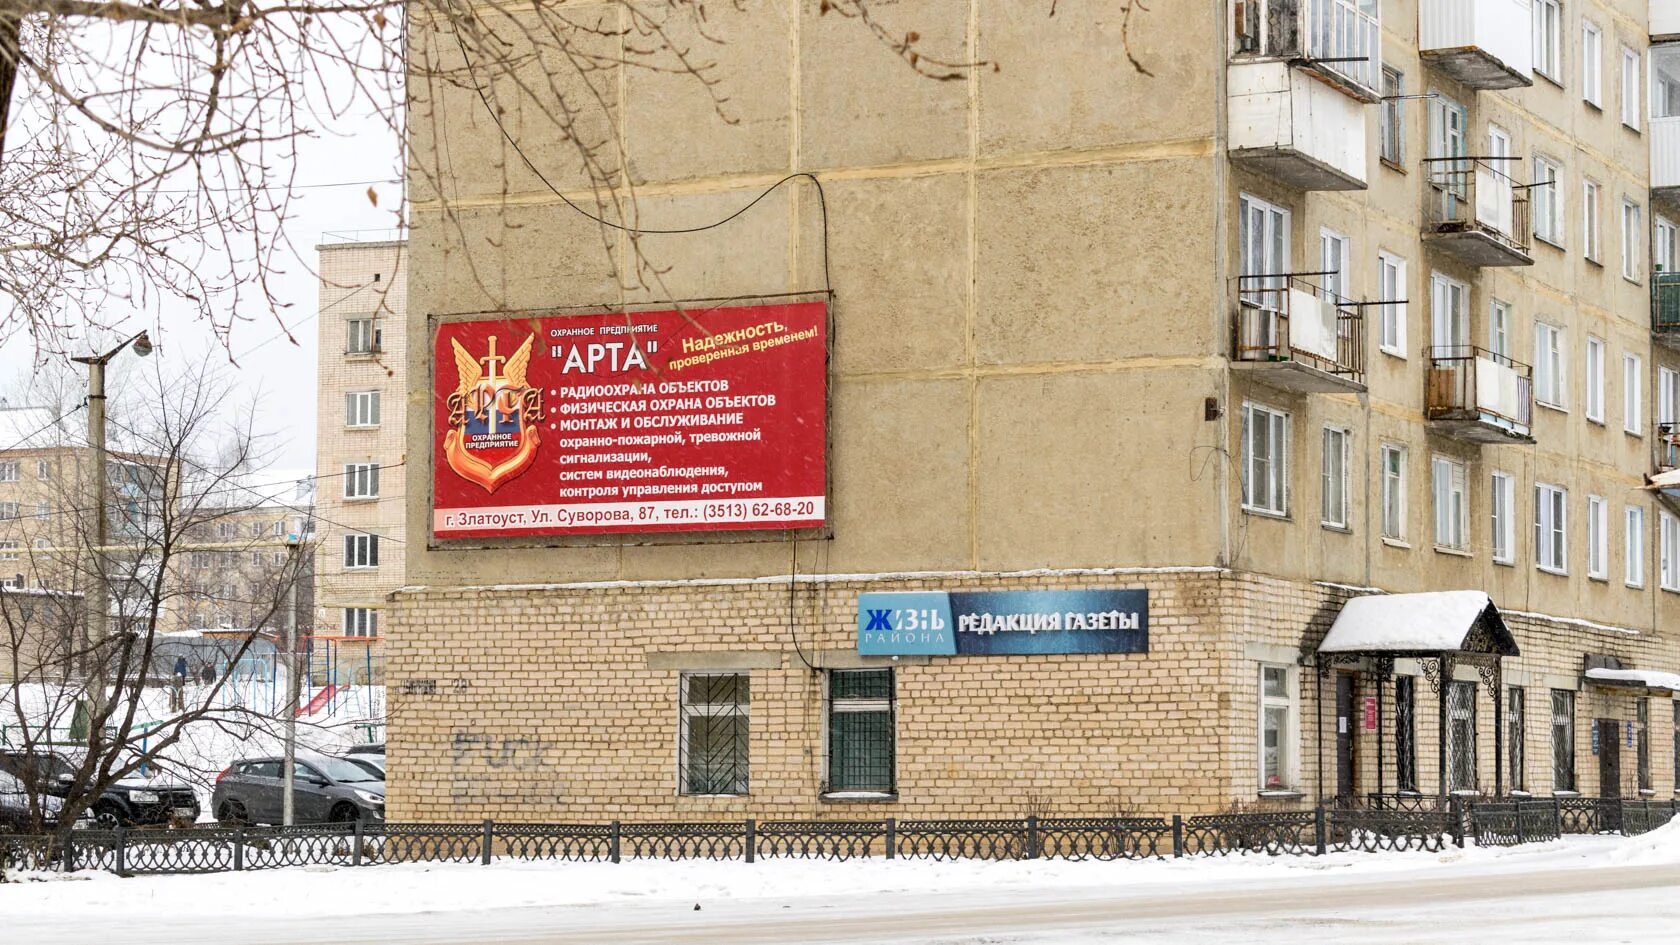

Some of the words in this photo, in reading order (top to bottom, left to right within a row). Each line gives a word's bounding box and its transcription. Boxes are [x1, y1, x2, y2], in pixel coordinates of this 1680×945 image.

[550, 327, 595, 337] ОХРАННОЕ
[599, 324, 658, 335] ПРЕДПРИЯТИЕ
[681, 321, 788, 354] Надежность,
[551, 340, 658, 374] "АРТА"
[668, 344, 750, 371] проверенная
[752, 325, 818, 352] временем!
[560, 383, 656, 399] РАДИООХРАНА
[658, 380, 729, 395] ОБЪЕКТОВ
[560, 400, 647, 415] ФИЗИЧЕСКАЯ
[649, 398, 702, 411] ОХРАНА
[705, 394, 776, 409] ОБЪЕКТОВ
[560, 417, 618, 431] МОНТАЖ
[621, 416, 630, 429] И
[633, 412, 744, 428] ОБСЛУЖИВАНИЕ
[465, 440, 519, 449] ПРЕДПРИЯТИЕ
[472, 433, 512, 441] ОХРАННОЕ
[559, 431, 686, 449] охранно-пожарной,
[689, 428, 761, 445] тревожной
[559, 451, 652, 466] сигнализации,
[559, 469, 603, 480] систем
[606, 465, 728, 480] видеонаблюдения,
[559, 485, 619, 498] контроля
[622, 483, 698, 497] управления
[701, 481, 763, 495] доступом
[446, 516, 454, 526] г.
[458, 512, 527, 527] Златоуст,
[531, 509, 552, 523] Ул.
[557, 508, 634, 525] Суворова,
[638, 506, 659, 521] 87,
[663, 507, 698, 519] тел.:
[703, 503, 747, 521] (3513)
[752, 501, 814, 517] 62-68-20
[958, 612, 1063, 635] РЕДАКЦИЯ
[1064, 609, 1140, 632] ГАЗЕТЫ
[865, 632, 944, 644] РАЙОНА
